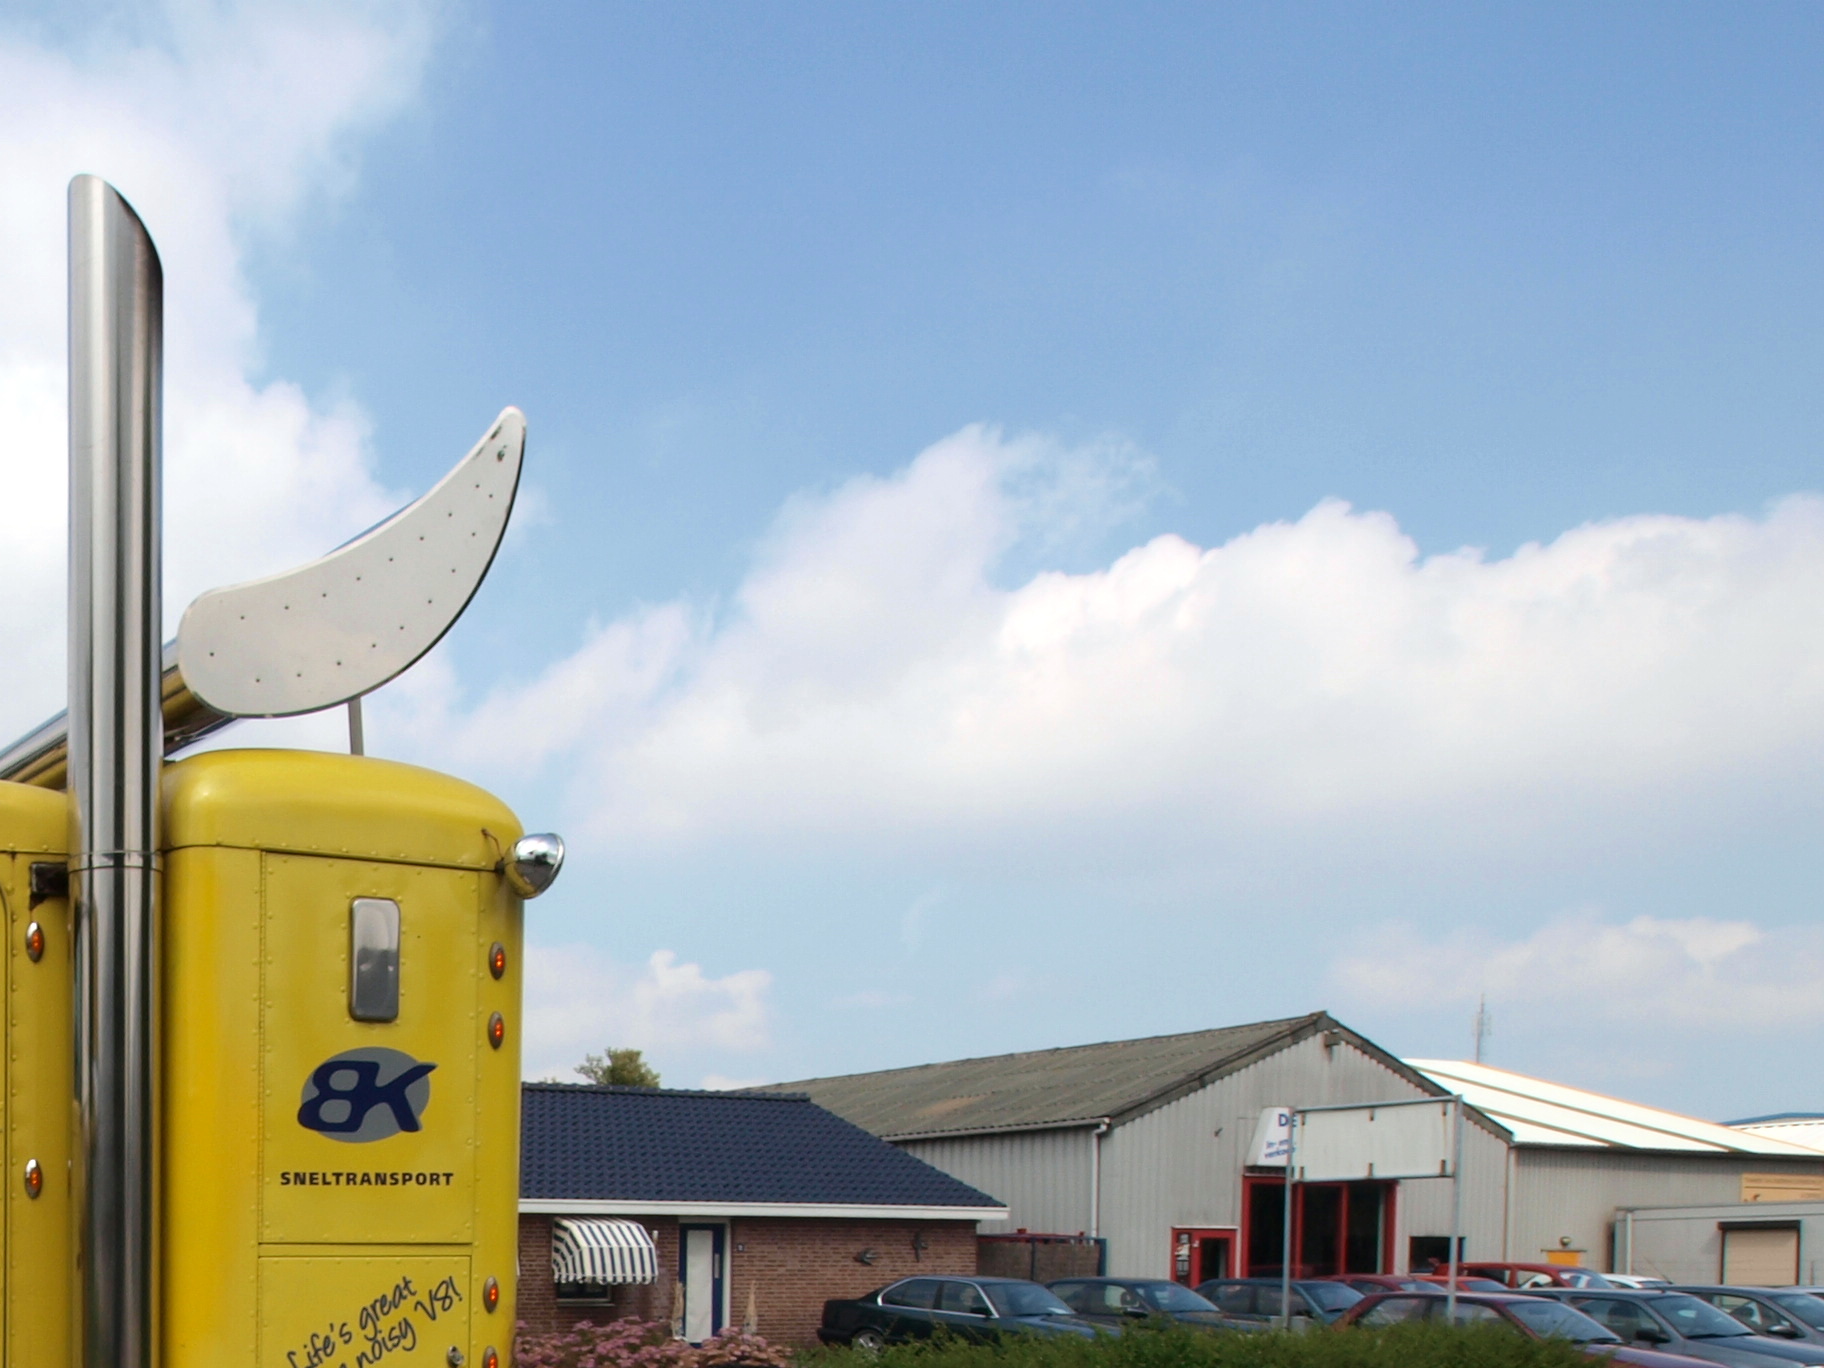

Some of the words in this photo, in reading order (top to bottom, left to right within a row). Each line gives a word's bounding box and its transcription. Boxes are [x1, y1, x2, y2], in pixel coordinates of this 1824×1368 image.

[279, 1170, 455, 1188] SNELTRANSPORT
[358, 1276, 417, 1341] great
[414, 1275, 463, 1321] V8!
